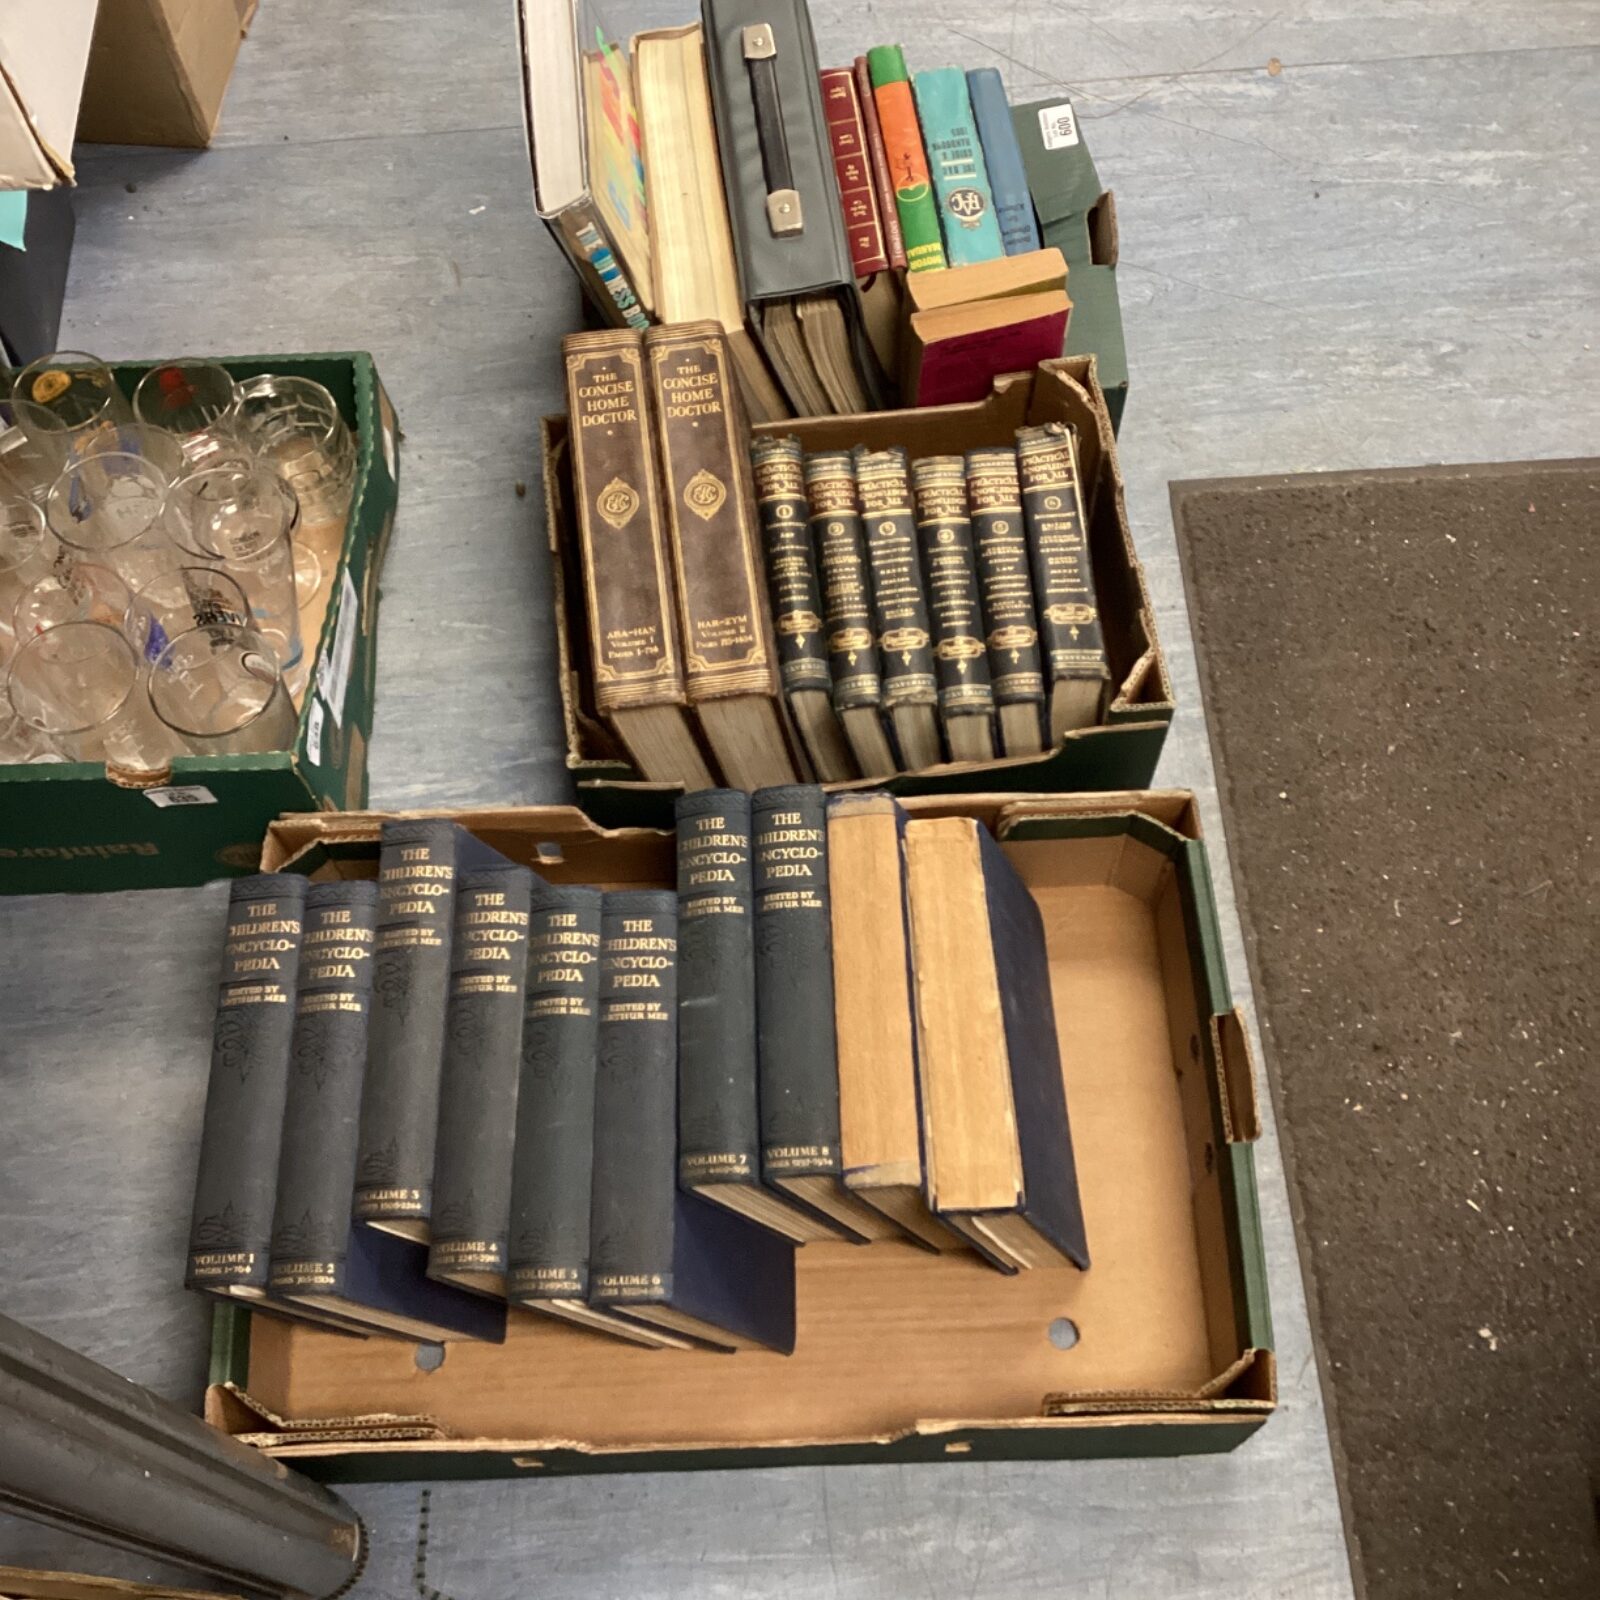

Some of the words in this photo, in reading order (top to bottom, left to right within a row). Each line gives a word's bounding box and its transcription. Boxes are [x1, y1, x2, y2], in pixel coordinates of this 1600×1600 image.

[1057, 116, 1073, 136] 600
[951, 192, 981, 214] RAC
[576, 222, 603, 252] THE
[591, 247, 636, 309] GUINNESS
[622, 304, 651, 331] BOO
[676, 364, 701, 375] THE
[592, 372, 618, 383] THE
[663, 373, 718, 390] CONCISE
[579, 380, 634, 398] CONCISE
[671, 388, 714, 404] HOME
[587, 396, 629, 412] HOME
[667, 401, 722, 418] DOCTOR
[582, 409, 638, 427] DOCTOR
[1030, 472, 1052, 484] FOR
[1052, 470, 1069, 479] ALL
[977, 495, 999, 505] FOR
[1000, 494, 1017, 503] ALL
[696, 817, 725, 831] THE
[772, 812, 802, 825] THE
[401, 848, 430, 861] THE
[690, 869, 735, 885] PEDIA
[766, 864, 812, 879] PEDIA
[475, 893, 505, 906] THE
[723, 896, 737, 905] BY
[801, 891, 815, 899] BY
[248, 904, 276, 917] THE
[390, 900, 435, 915] PEDIA
[724, 906, 744, 914] MEE
[801, 900, 822, 908] MEE
[321, 910, 351, 923] THE
[548, 914, 577, 927] THE
[623, 919, 653, 932] THE
[420, 928, 435, 937] BY
[420, 938, 442, 946] MEE
[465, 946, 511, 960] PEDIA
[234, 957, 280, 972] PEDIA
[309, 965, 355, 979] PEDIA
[538, 968, 584, 983] PEDIA
[496, 975, 511, 984] BY
[613, 974, 660, 988] PEDIA
[265, 985, 280, 994] BY
[495, 984, 518, 993] MEE
[264, 994, 287, 1003] MEE
[339, 993, 355, 1001] BY
[569, 997, 585, 1006] BY
[339, 1003, 362, 1012] MEE
[569, 1007, 591, 1016] MEE
[649, 1003, 661, 1011] BY
[649, 1012, 668, 1020] MEE
